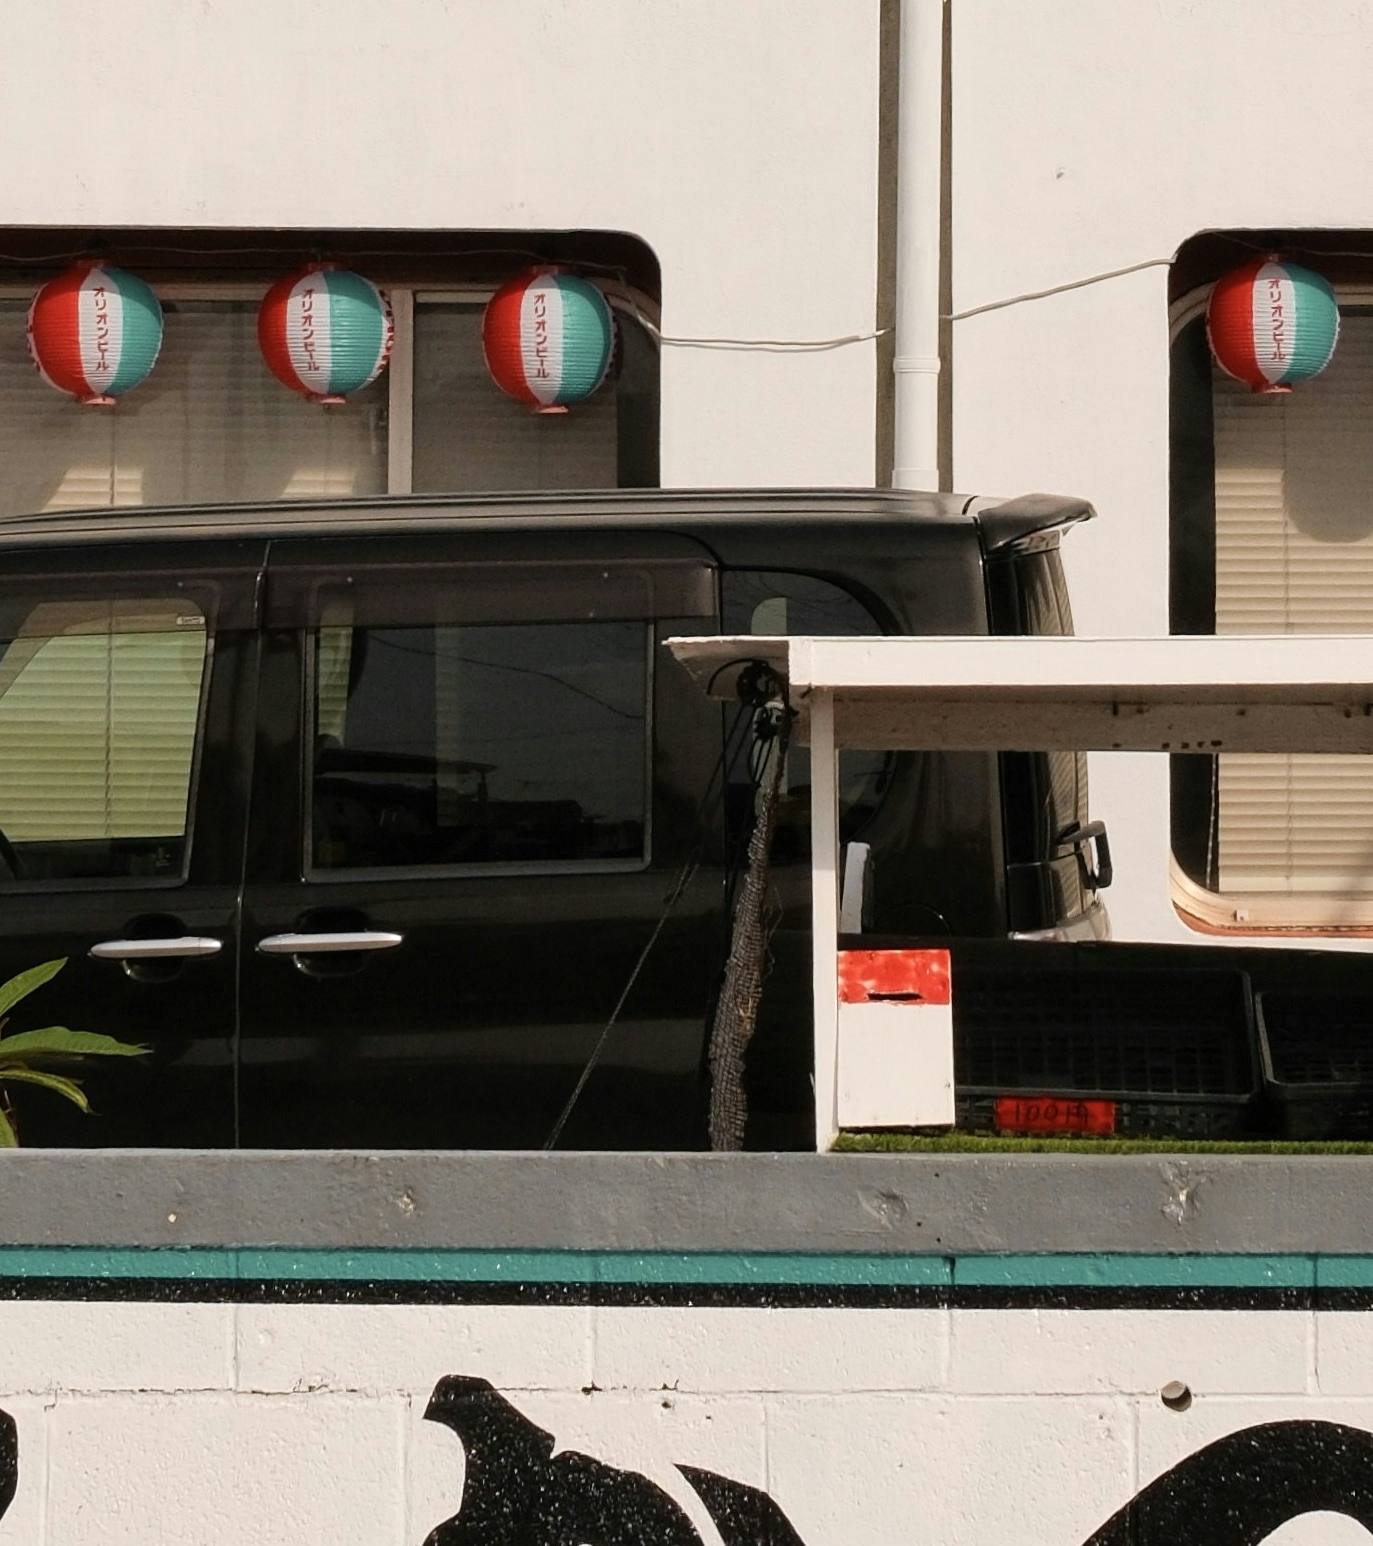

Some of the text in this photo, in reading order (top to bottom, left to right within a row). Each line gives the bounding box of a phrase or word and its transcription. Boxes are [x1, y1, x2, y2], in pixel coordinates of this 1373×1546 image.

[93, 286, 111, 372] オリオンビール
[301, 288, 320, 372] オリオンビール
[534, 293, 550, 379] オリオンビール
[1267, 278, 1286, 361] オリオンビール
